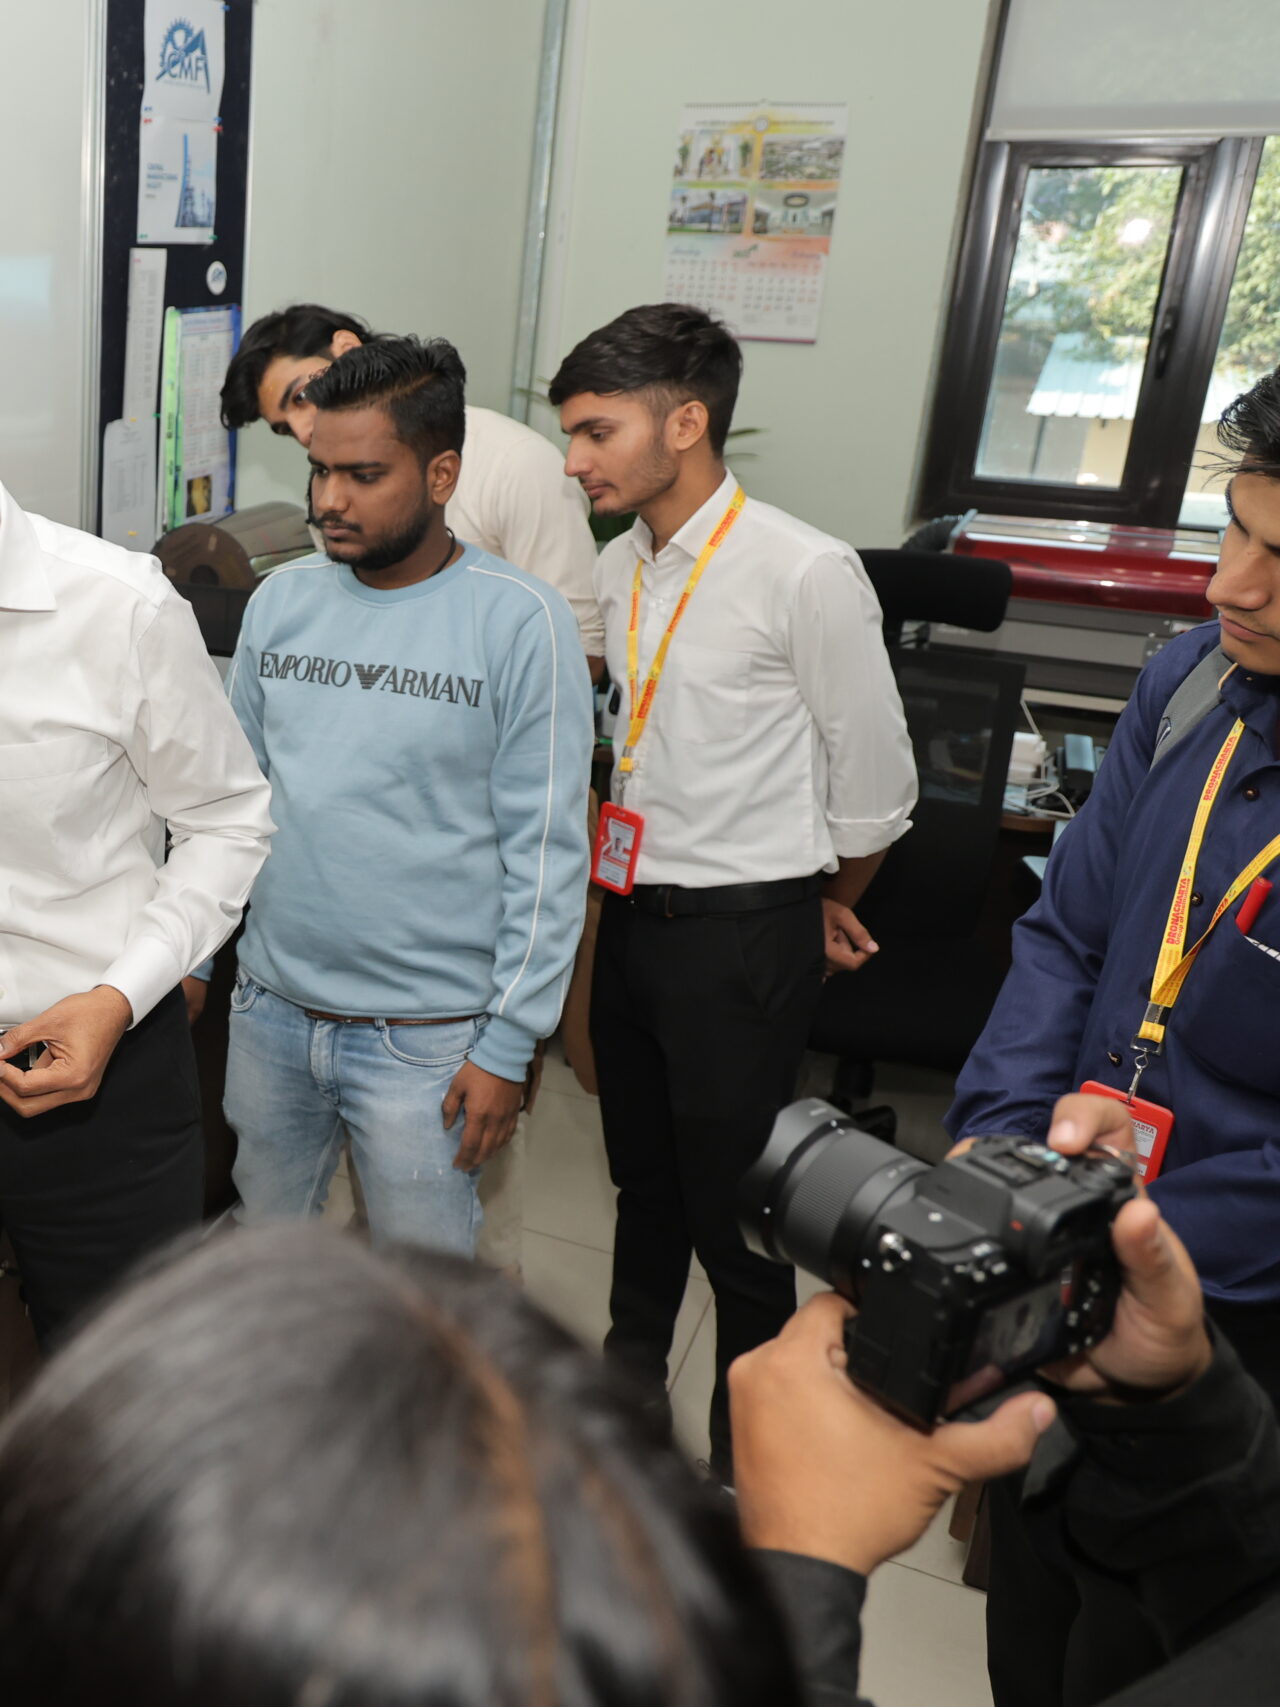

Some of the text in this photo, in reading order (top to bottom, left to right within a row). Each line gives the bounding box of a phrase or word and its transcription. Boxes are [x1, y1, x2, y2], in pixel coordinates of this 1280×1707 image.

[259, 652, 484, 707] EMPORIO ARMANI
[1203, 736, 1236, 801] DRONACHARYA
[1166, 878, 1188, 945] DRONACHARYA
[1175, 924, 1185, 945] Group
[1180, 878, 1191, 914] Institutions
